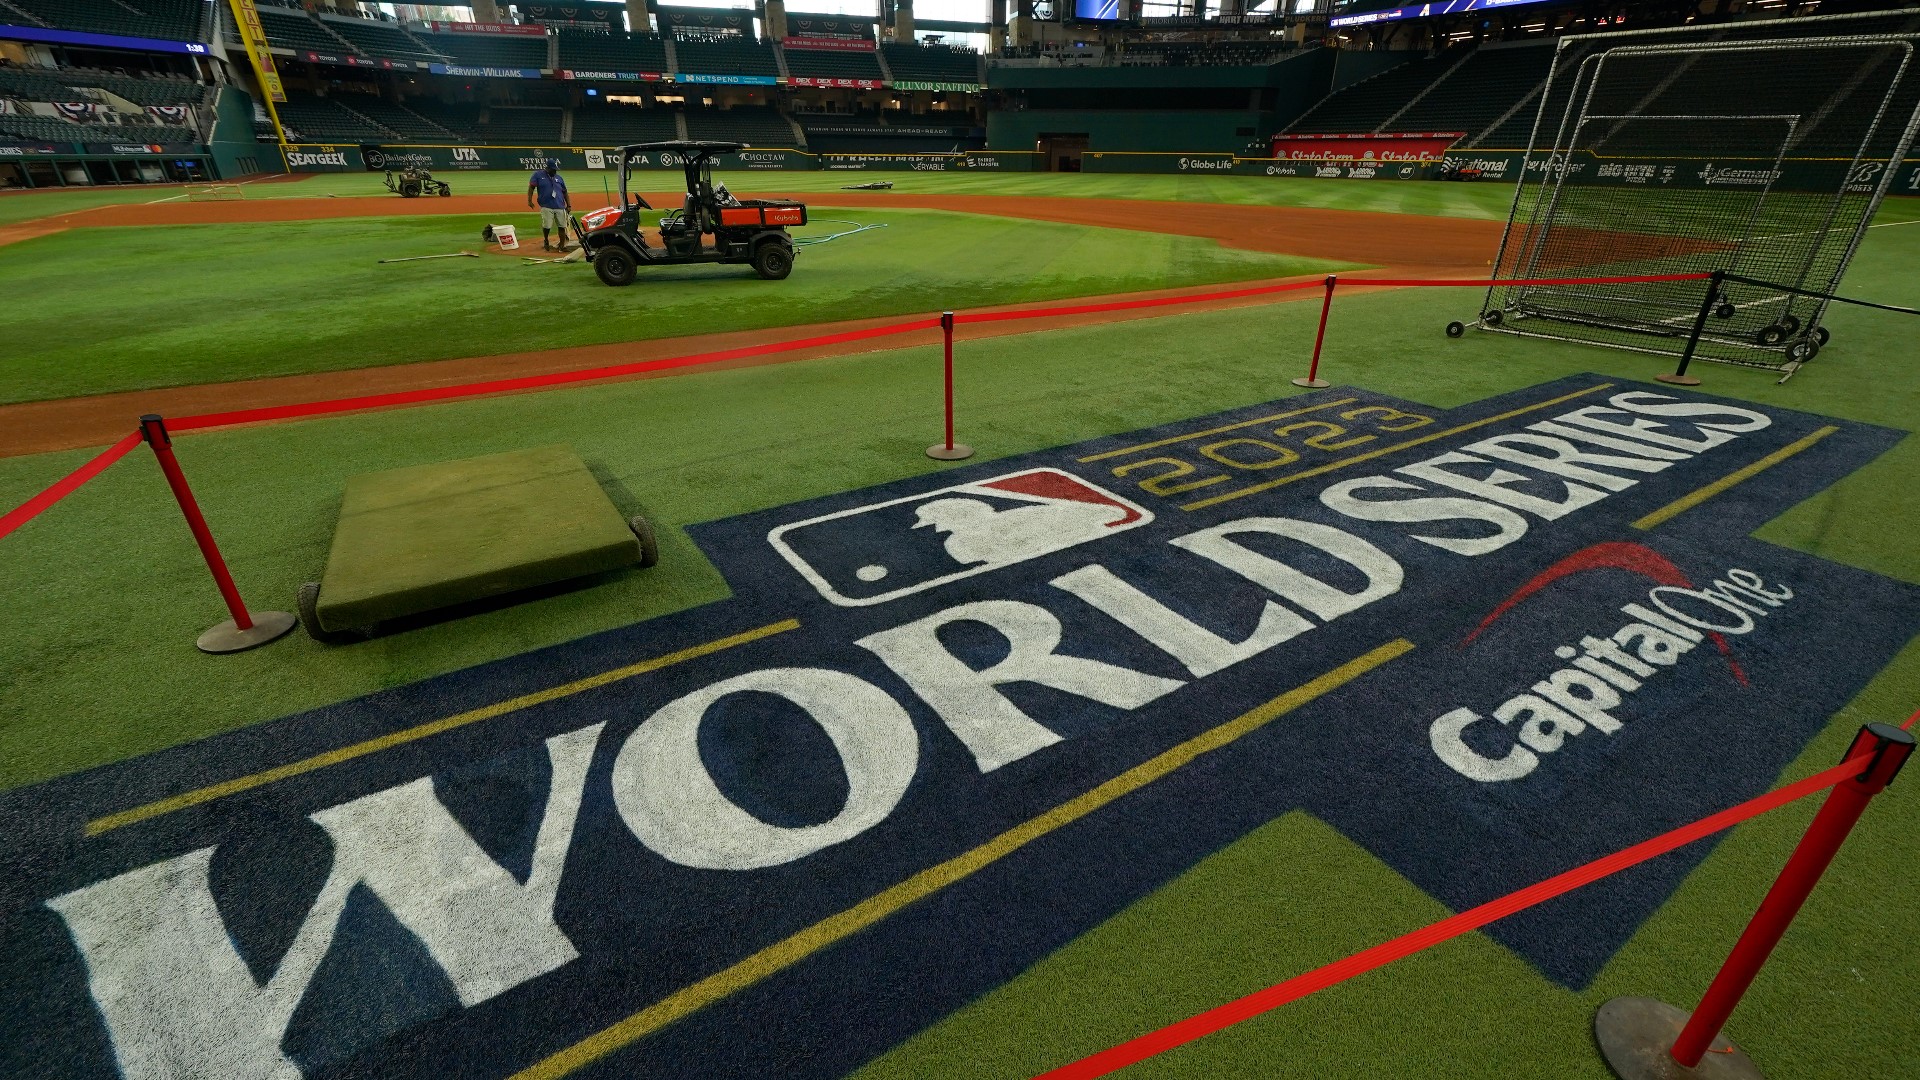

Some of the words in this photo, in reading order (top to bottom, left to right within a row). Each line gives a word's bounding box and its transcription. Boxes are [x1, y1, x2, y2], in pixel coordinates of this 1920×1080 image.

[1219, 15, 1240, 24] HART
[1243, 15, 1266, 23] HVAC
[1285, 15, 1327, 23] PLUCKERS
[1338, 17, 1357, 26] WORLD
[1357, 14, 1377, 24] SERIES
[575, 71, 617, 79] GARDENERS
[695, 75, 739, 83] NETSPEND
[902, 81, 933, 90] LUXOR
[935, 82, 979, 92] STAFFING
[286, 152, 348, 166] SEATGEEK
[452, 148, 480, 160] UTA
[606, 155, 650, 164] TOOTA
[1190, 160, 1215, 169] Globe
[1216, 160, 1232, 169] Life
[774, 214, 799, 222] Kubota
[1112, 406, 1435, 497] 2023
[1429, 603, 1703, 783] Capital
[46, 516, 1405, 1080] WORLD
[1320, 390, 1772, 556] SERIES
